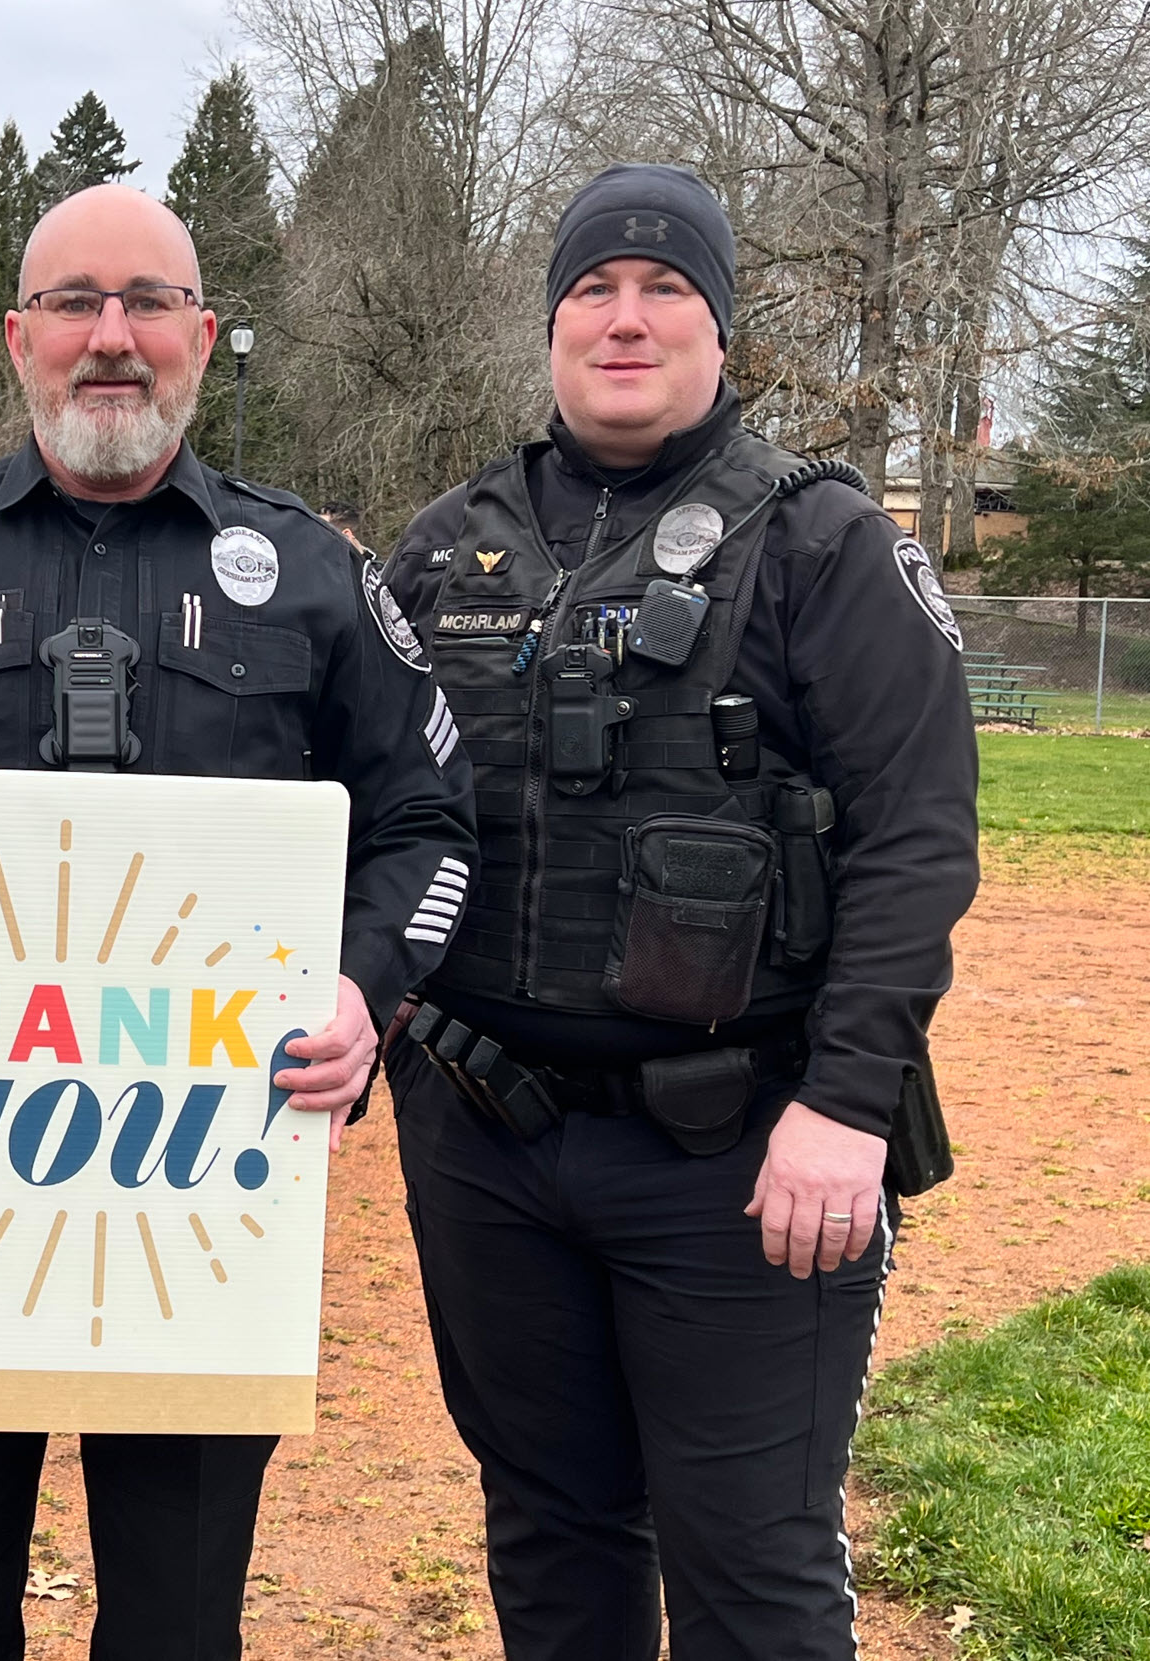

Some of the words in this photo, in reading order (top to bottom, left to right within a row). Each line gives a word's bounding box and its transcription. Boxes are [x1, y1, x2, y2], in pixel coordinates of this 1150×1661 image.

[221, 529, 267, 545] SERGEANT
[689, 544, 713, 556] POLIC
[438, 613, 522, 630] MCFARLAND
